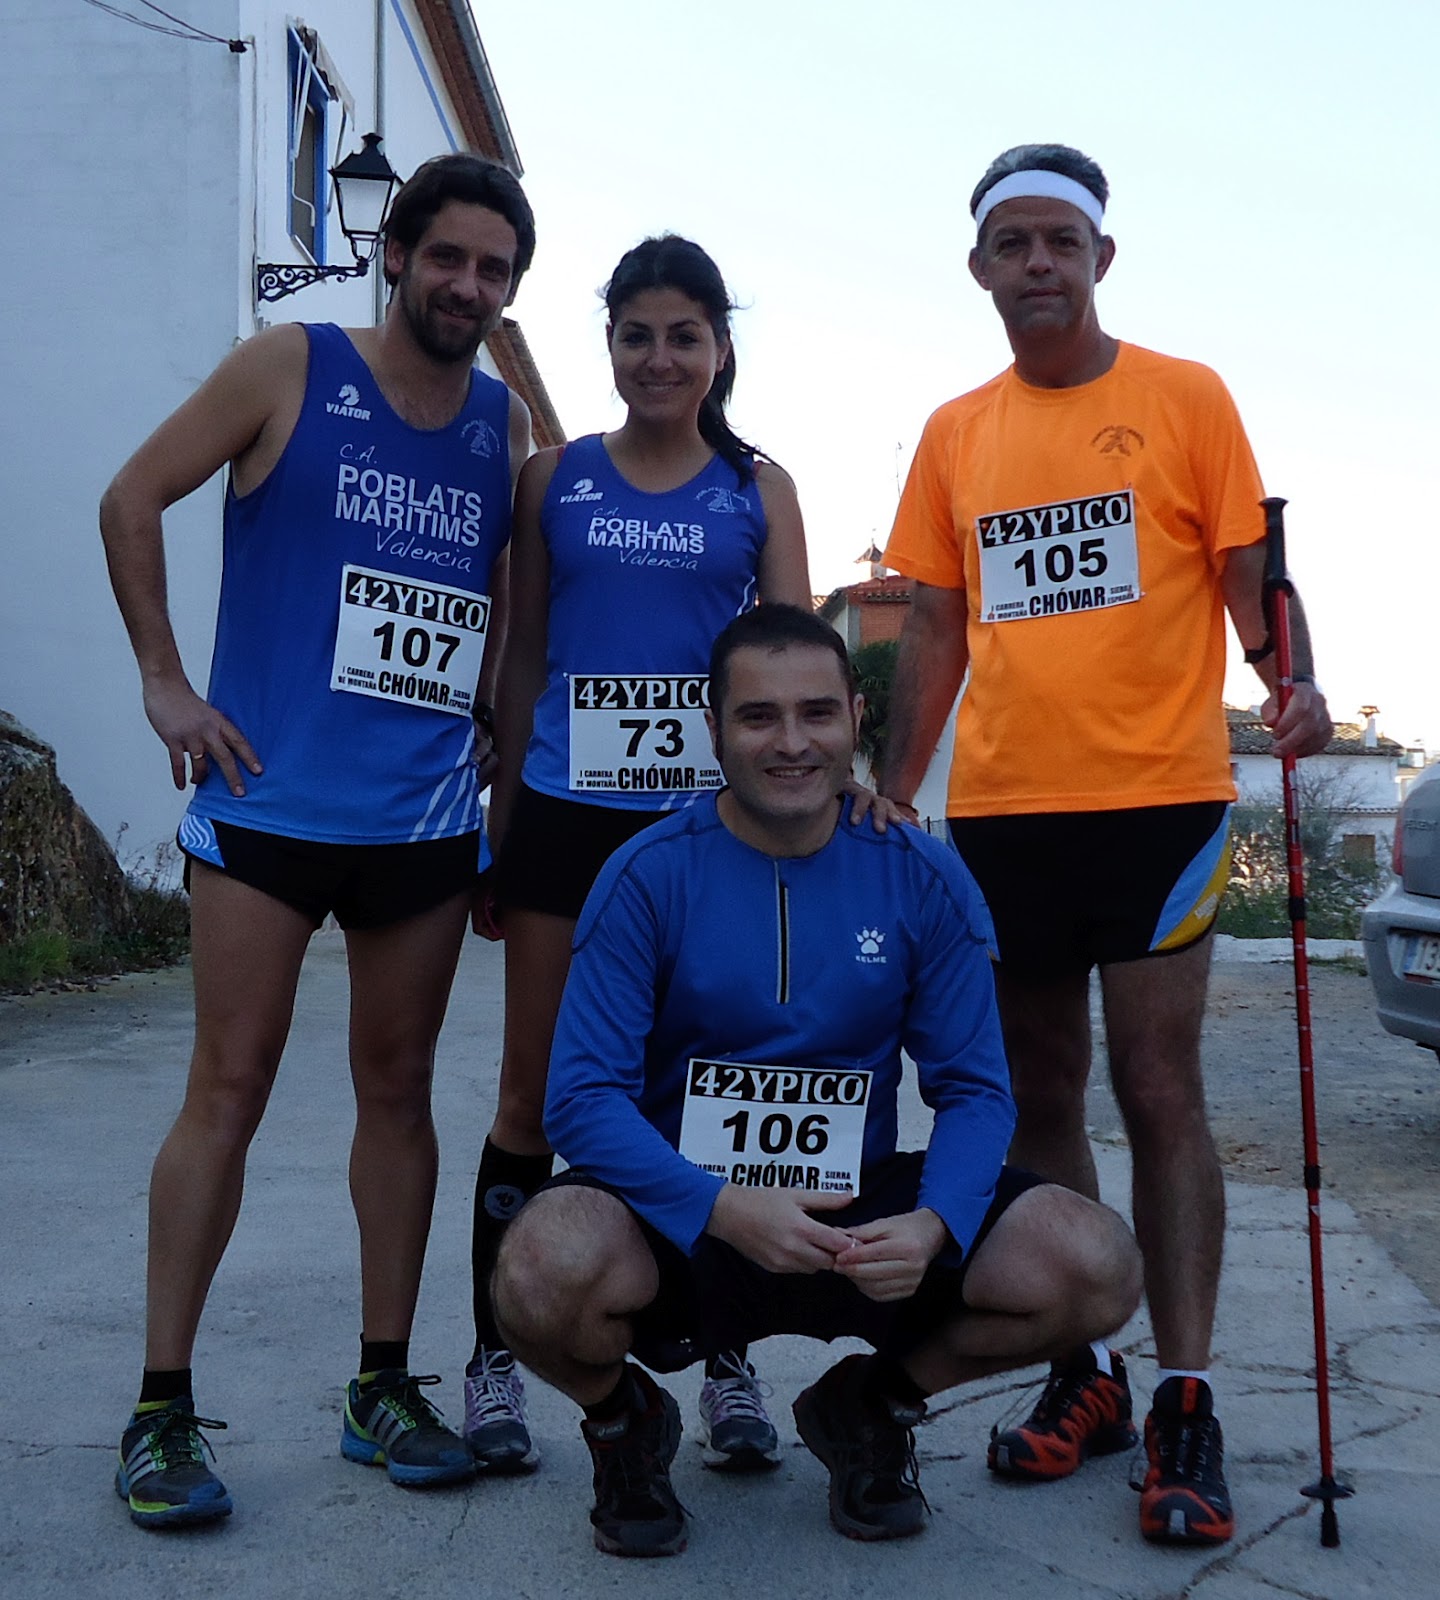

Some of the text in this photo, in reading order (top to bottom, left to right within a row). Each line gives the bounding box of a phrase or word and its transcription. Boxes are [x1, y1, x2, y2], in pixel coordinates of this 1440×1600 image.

[326, 402, 371, 421] VIATOR
[340, 443, 378, 464] C.A.
[338, 463, 482, 521] POBLATS
[560, 491, 603, 503] VIATOR
[335, 491, 480, 548] MARITIMS
[590, 518, 705, 539] POBLATS
[986, 496, 1129, 545] 42YPICO
[375, 529, 472, 573] Valencia
[587, 530, 705, 555] MARITIMS
[619, 548, 699, 571] Valencia
[1014, 538, 1108, 587] 105
[349, 577, 485, 630] 42YPICO
[995, 601, 1024, 611] CARRERA
[1029, 587, 1106, 616] CHÓVAR
[373, 621, 461, 673] 107
[347, 666, 375, 679] CARRERA
[378, 670, 450, 706] CHÓVAR
[619, 718, 685, 758] 73
[618, 763, 696, 789] CHÓVAR
[695, 1065, 864, 1104] 42YPICO
[722, 1110, 830, 1155] 106
[731, 1161, 820, 1190] CHÓVAR
[825, 1170, 851, 1180] SIERRA
